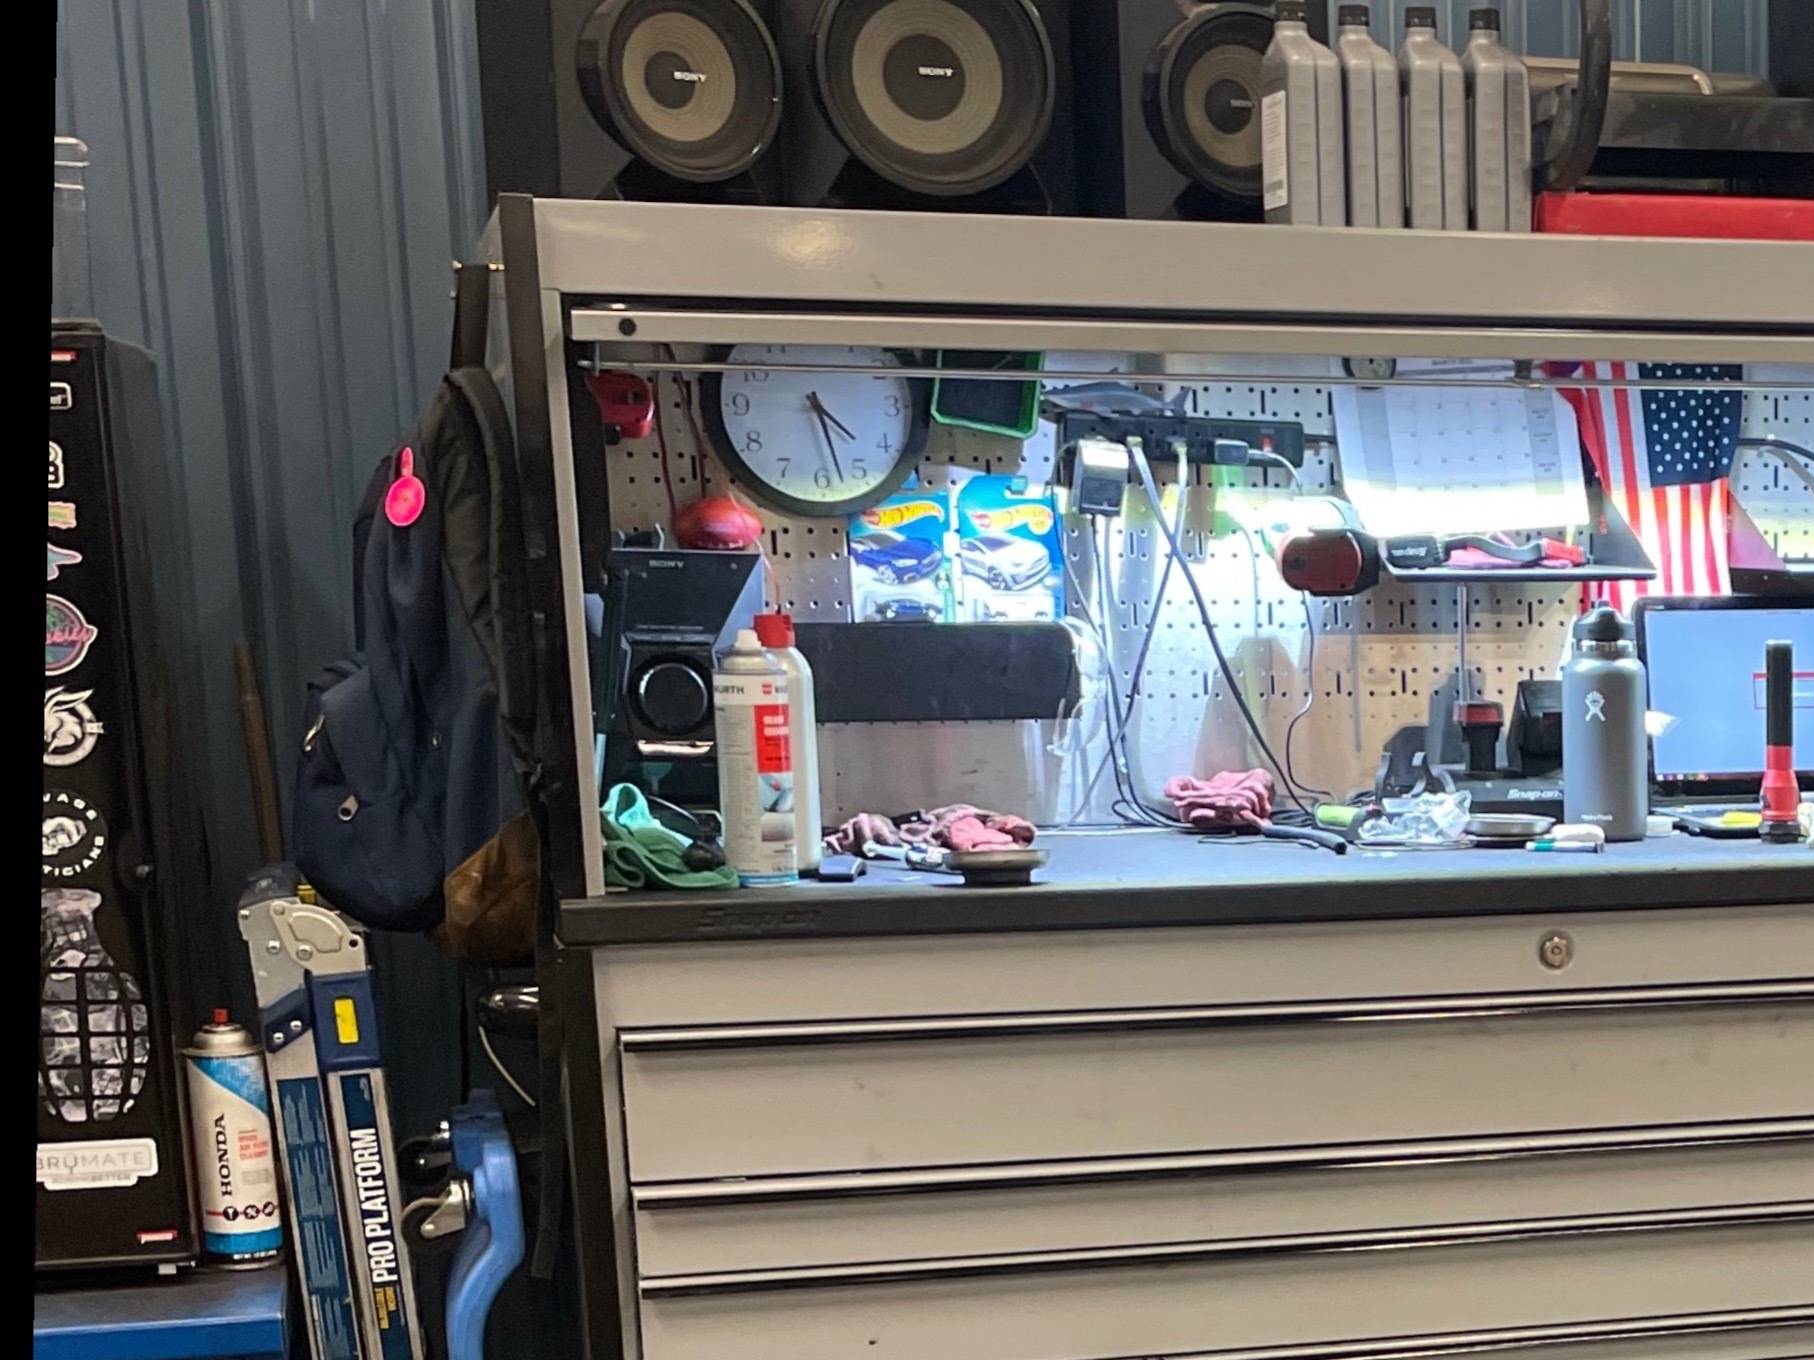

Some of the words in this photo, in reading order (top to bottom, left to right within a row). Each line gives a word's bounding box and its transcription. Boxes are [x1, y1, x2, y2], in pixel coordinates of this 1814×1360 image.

[673, 71, 706, 82] SONY
[918, 66, 953, 77] SONY
[731, 392, 750, 417] 9
[883, 395, 900, 418] 3
[745, 430, 763, 452] 8
[876, 433, 892, 454] 4
[776, 457, 791, 479] 7
[813, 467, 831, 490] 6
[851, 458, 868, 480] 5
[648, 559, 685, 568] SONY
[1507, 788, 1560, 801] Snap-on
[214, 1112, 233, 1198] HONDA
[350, 1127, 392, 1238] PLATFORM
[368, 1239, 398, 1283] PRO
